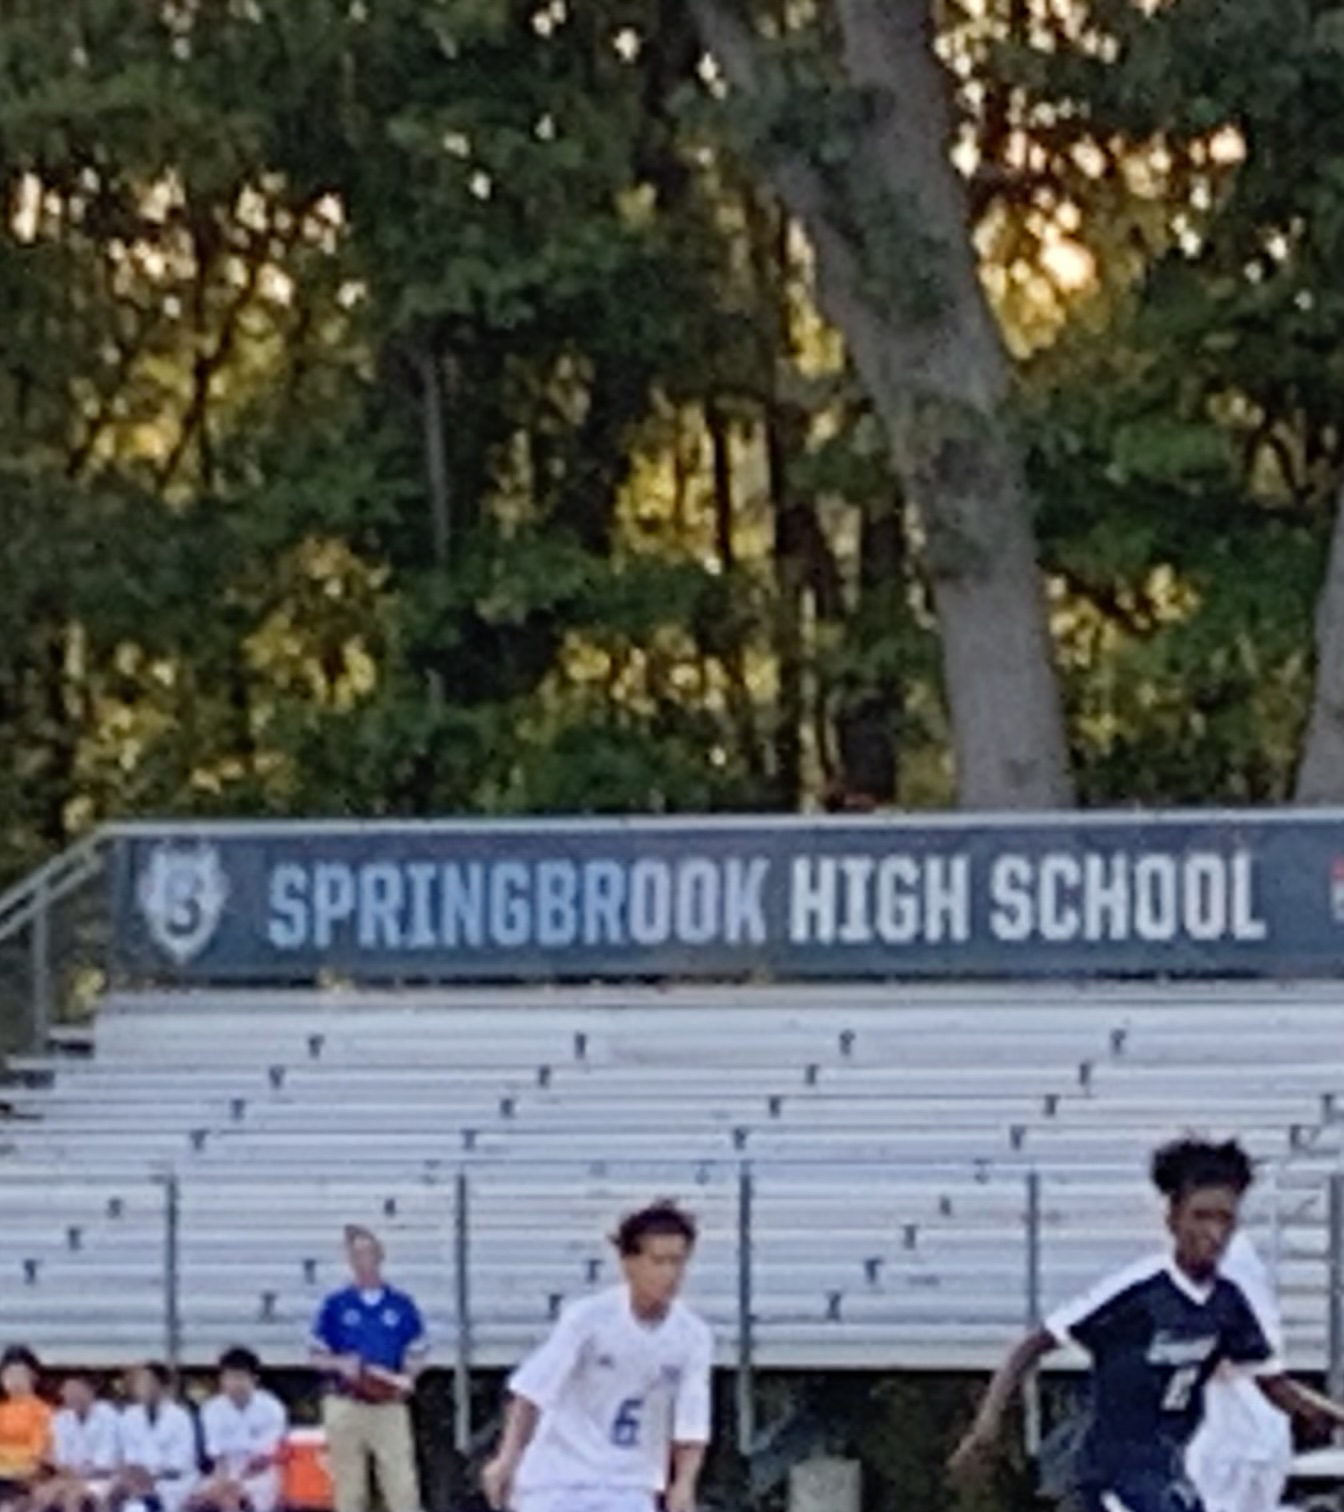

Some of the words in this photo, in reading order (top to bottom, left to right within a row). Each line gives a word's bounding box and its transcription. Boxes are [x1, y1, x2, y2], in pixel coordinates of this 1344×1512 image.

[267, 860, 766, 949] SPRINGBROOK
[789, 854, 968, 944] HIGH
[990, 850, 1265, 942] SCHOOL
[611, 1398, 643, 1448] 6
